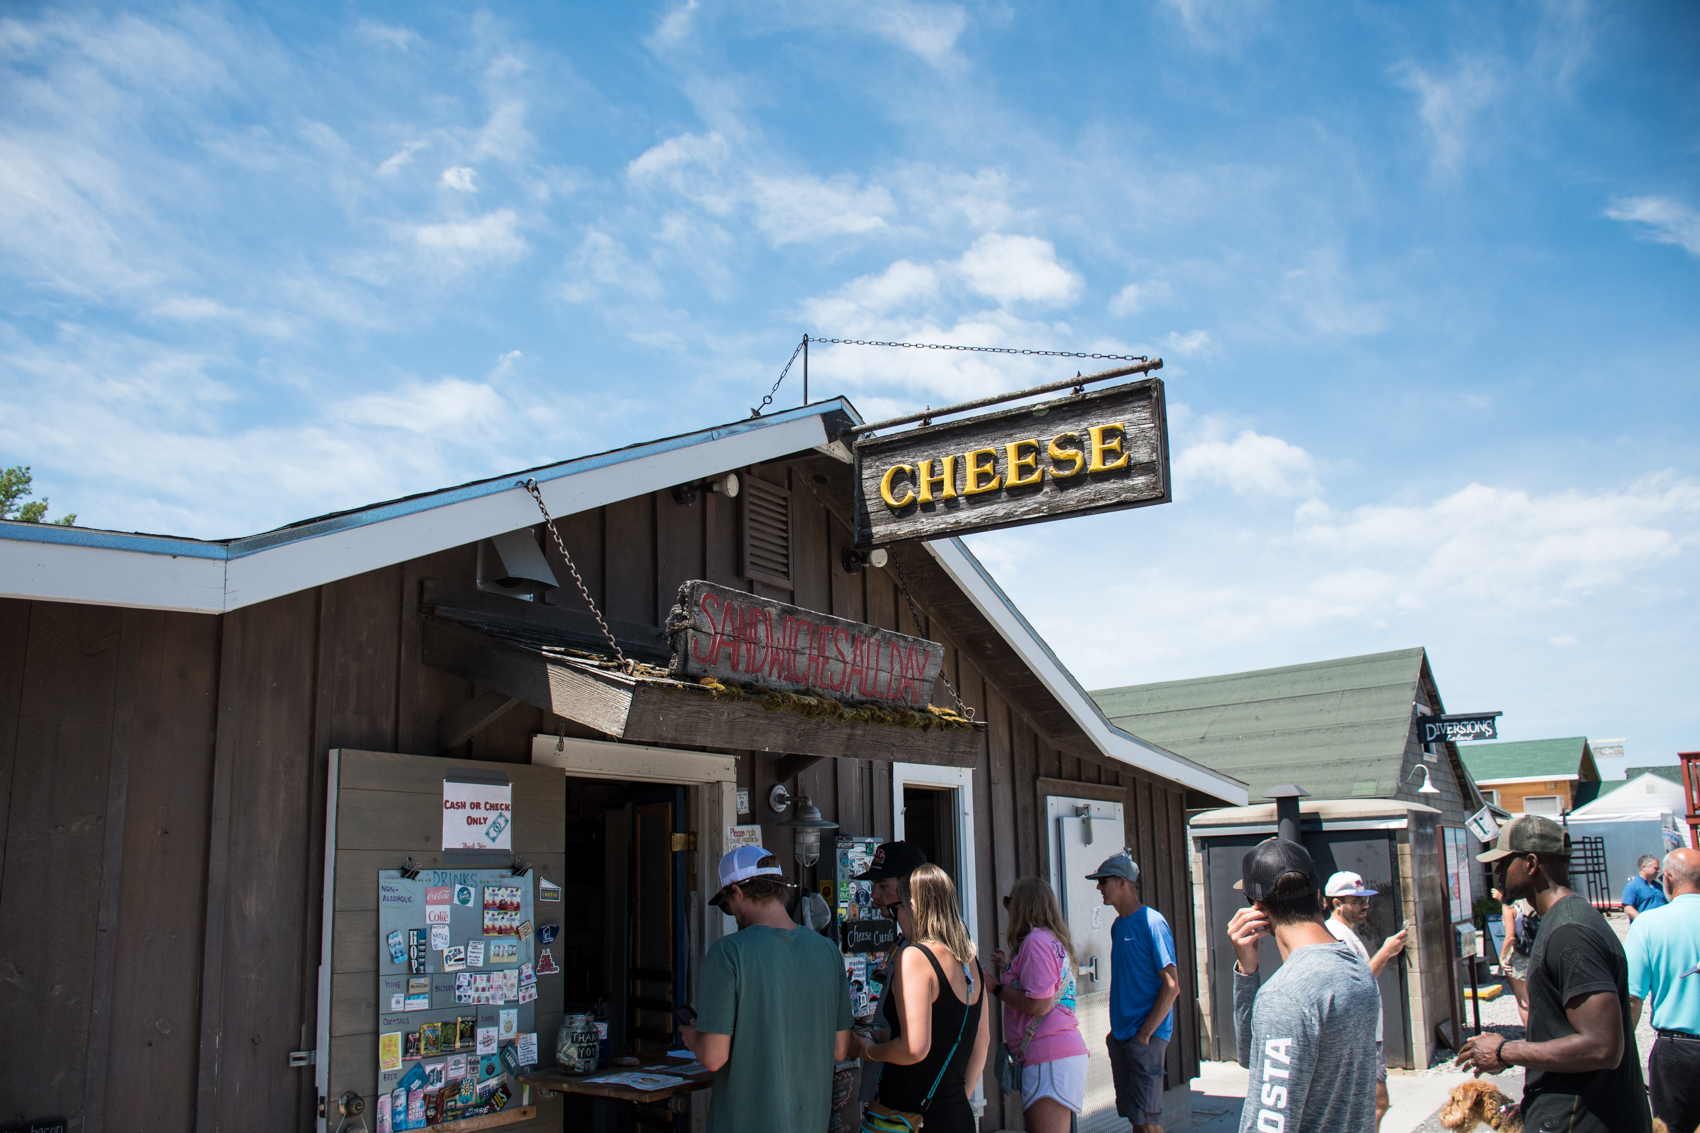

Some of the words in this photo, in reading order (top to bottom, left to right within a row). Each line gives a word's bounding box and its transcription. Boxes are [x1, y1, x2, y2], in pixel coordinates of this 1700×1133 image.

[879, 422, 1130, 508] CHEESE
[693, 593, 849, 692] SANDWICHES
[846, 632, 884, 698] ALL
[887, 641, 930, 704] DAY
[1425, 719, 1493, 741] DIVERSIONS
[444, 800, 466, 811] CASH
[484, 801, 511, 812] CHECK
[466, 815, 489, 826] ONLY
[433, 871, 478, 888] DRINKS
[382, 894, 413, 903] ALCOHOLIC
[428, 911, 449, 922] Coke
[848, 925, 872, 948] Cheese
[873, 928, 894, 946] Curds
[385, 980, 401, 989] WINE
[382, 1017, 410, 1026] COCKTAILS
[383, 1073, 398, 1081] BEER
